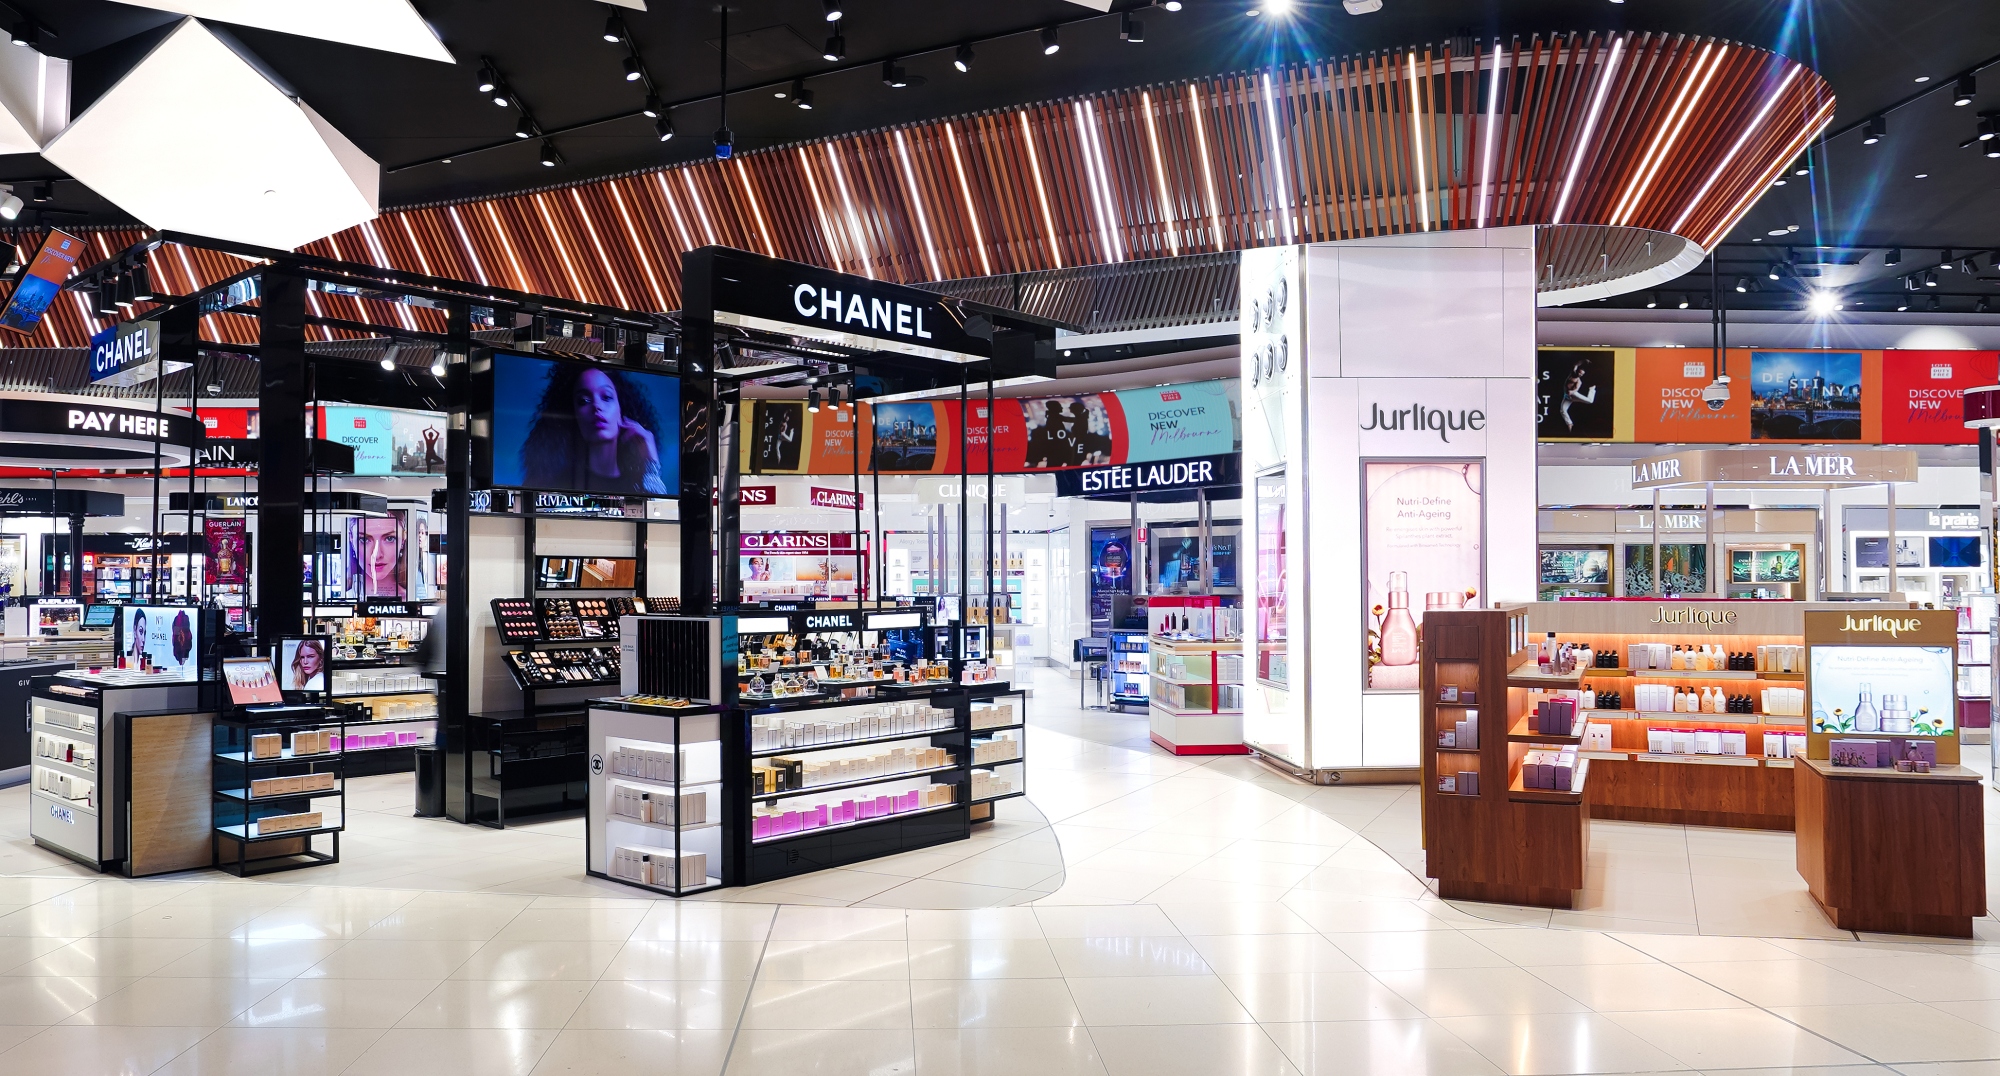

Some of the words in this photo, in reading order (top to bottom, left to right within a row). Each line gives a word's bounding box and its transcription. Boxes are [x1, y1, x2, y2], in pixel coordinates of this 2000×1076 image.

[794, 283, 932, 339] CHANEL
[96, 327, 151, 373] CHANEL
[1762, 373, 1846, 397] DESTINY
[1662, 399, 1694, 409] NEW
[1909, 400, 1941, 410] NEW
[1148, 406, 1206, 421] DISCOVER
[68, 409, 115, 432] PAY
[119, 414, 169, 438] HERE
[878, 418, 928, 436] DESTINY
[1150, 420, 1179, 431] NEW
[1360, 402, 1486, 443] Jurlique
[342, 436, 379, 444] DISCOVER
[826, 430, 859, 438] DISCOVE
[966, 436, 989, 445] NEW
[1047, 430, 1084, 454] LOVE
[1151, 426, 1222, 446] Melbourne
[1137, 460, 1213, 487] LAUDER
[1632, 464, 1649, 484] LA
[1650, 458, 1682, 480] MER
[1769, 456, 1802, 476] LA
[1804, 455, 1856, 476] MER
[535, 493, 584, 507] RMANI
[817, 491, 857, 506] CLARINS
[1396, 496, 1452, 506] Nutri-Define
[1397, 509, 1451, 520] Anti-Ageing
[1664, 514, 1702, 529] MER
[1928, 511, 1940, 526] la
[1941, 512, 1980, 529] prairie
[744, 535, 828, 547] CLARINS
[367, 605, 409, 614] CHANEL
[806, 614, 853, 628] CHANEL
[1650, 605, 1738, 632] Jurlique
[1839, 613, 1922, 639] Jurlique
[50, 805, 74, 825] CHANEL
